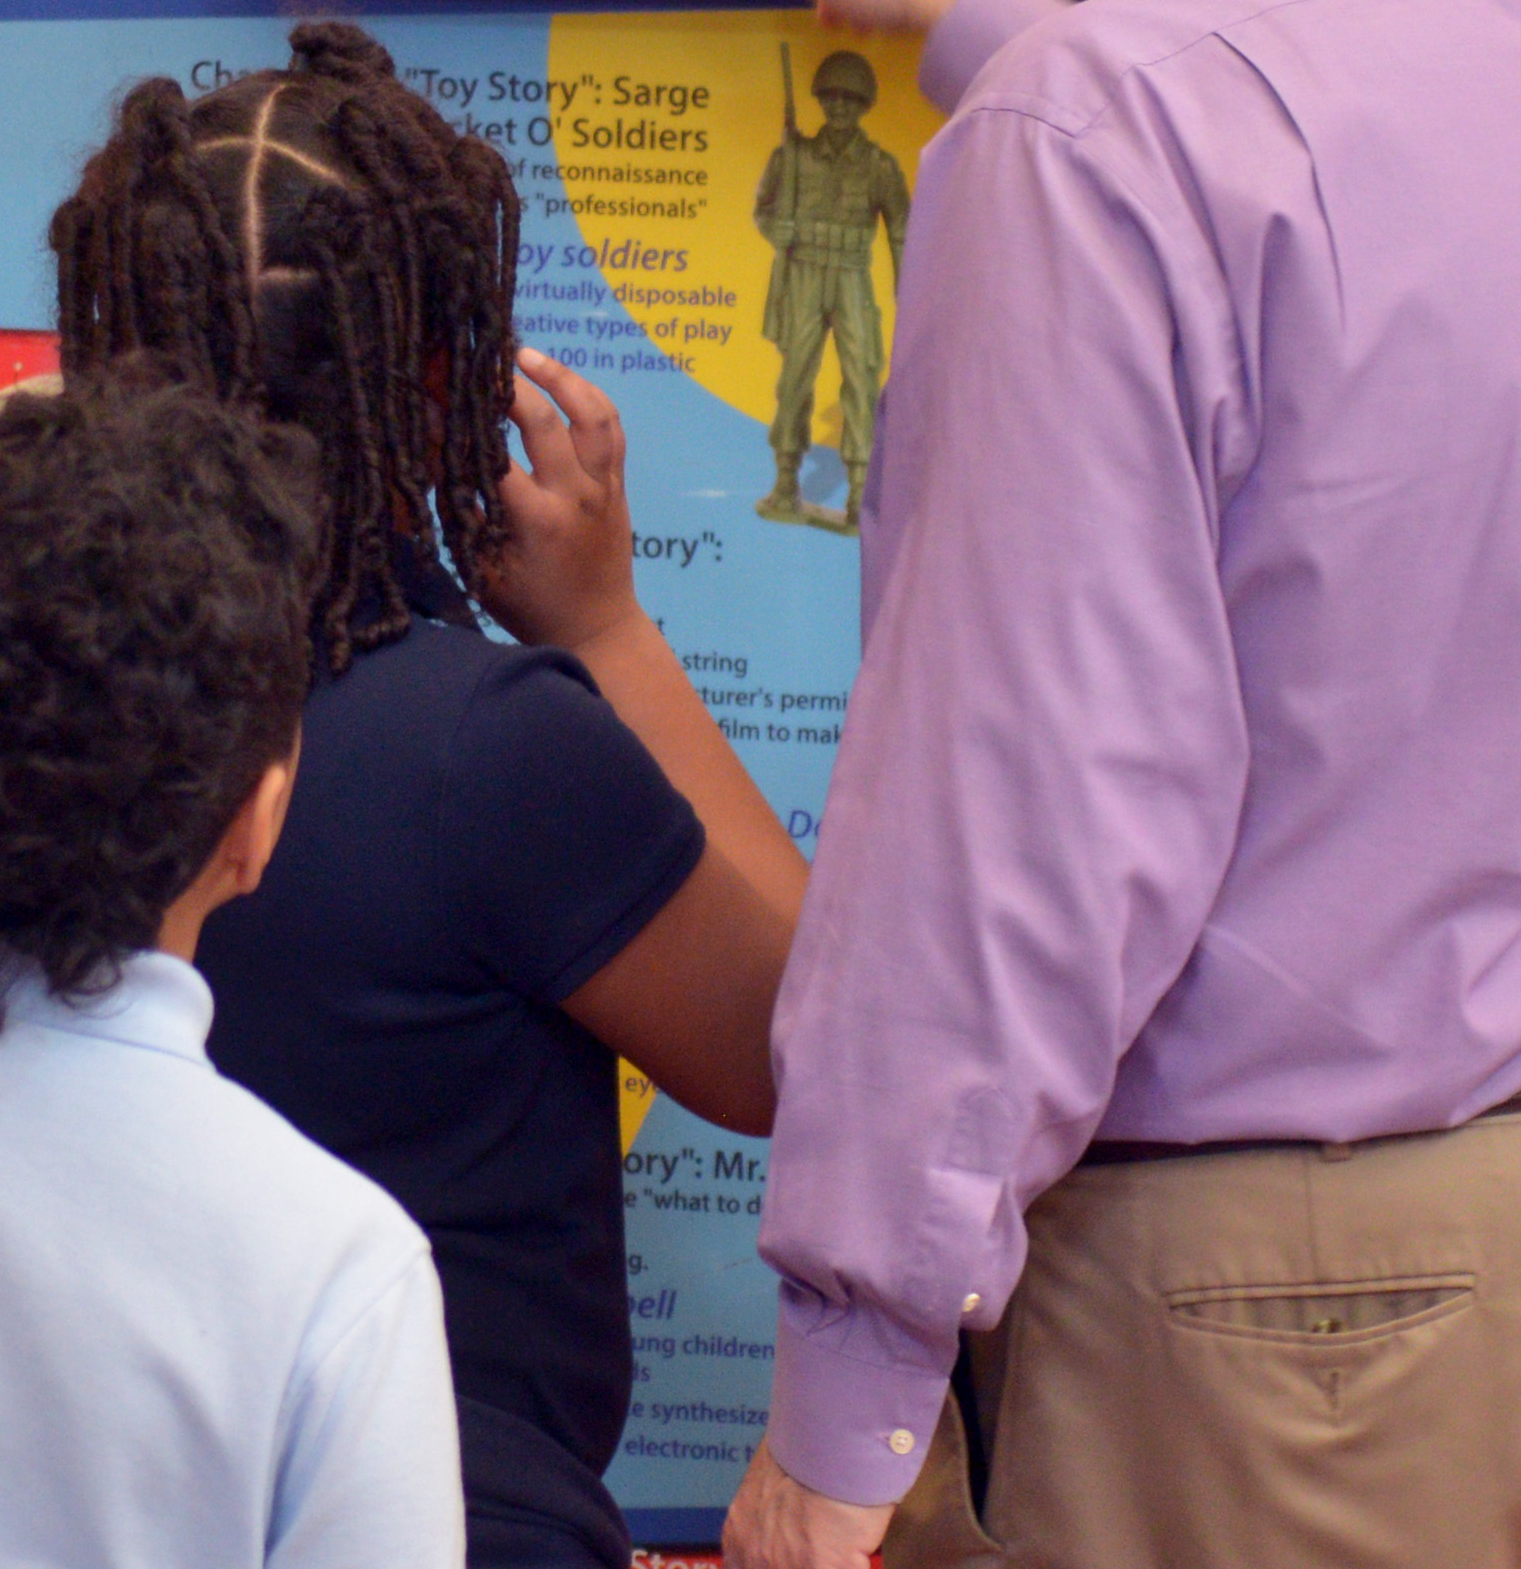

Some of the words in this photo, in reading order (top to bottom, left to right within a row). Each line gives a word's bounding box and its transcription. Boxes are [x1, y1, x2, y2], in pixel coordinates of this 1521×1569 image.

[406, 68, 478, 107] "Toy
[489, 72, 602, 111] Story":
[614, 77, 709, 115] Sarge
[455, 114, 517, 146] ket
[528, 117, 562, 146] O'
[573, 118, 708, 152] Soldiers
[508, 161, 525, 180] of
[532, 161, 708, 186] reconnaissance
[536, 193, 708, 219] "professionals"
[517, 244, 553, 270] oy
[562, 239, 689, 271] soldiers
[515, 280, 607, 305] virtually
[614, 282, 737, 310] disposable
[513, 315, 579, 334] eative
[587, 317, 649, 340] types
[655, 318, 679, 338] of
[683, 320, 733, 345] play
[595, 348, 615, 369] in
[622, 349, 696, 373] plastic
[632, 531, 723, 568] tory":
[682, 652, 748, 678] string
[698, 687, 774, 708] turer's
[780, 691, 848, 713] permi
[767, 723, 790, 742] to
[797, 724, 842, 745] mak
[625, 1077, 657, 1098] ey
[624, 1148, 703, 1184] ory":
[714, 1151, 766, 1181] Mr.
[644, 1188, 709, 1213] "what
[718, 1194, 741, 1214] to
[633, 1337, 676, 1359] ung
[682, 1335, 775, 1360] children
[652, 1401, 769, 1425] synthesize
[625, 1436, 739, 1462] electronic
